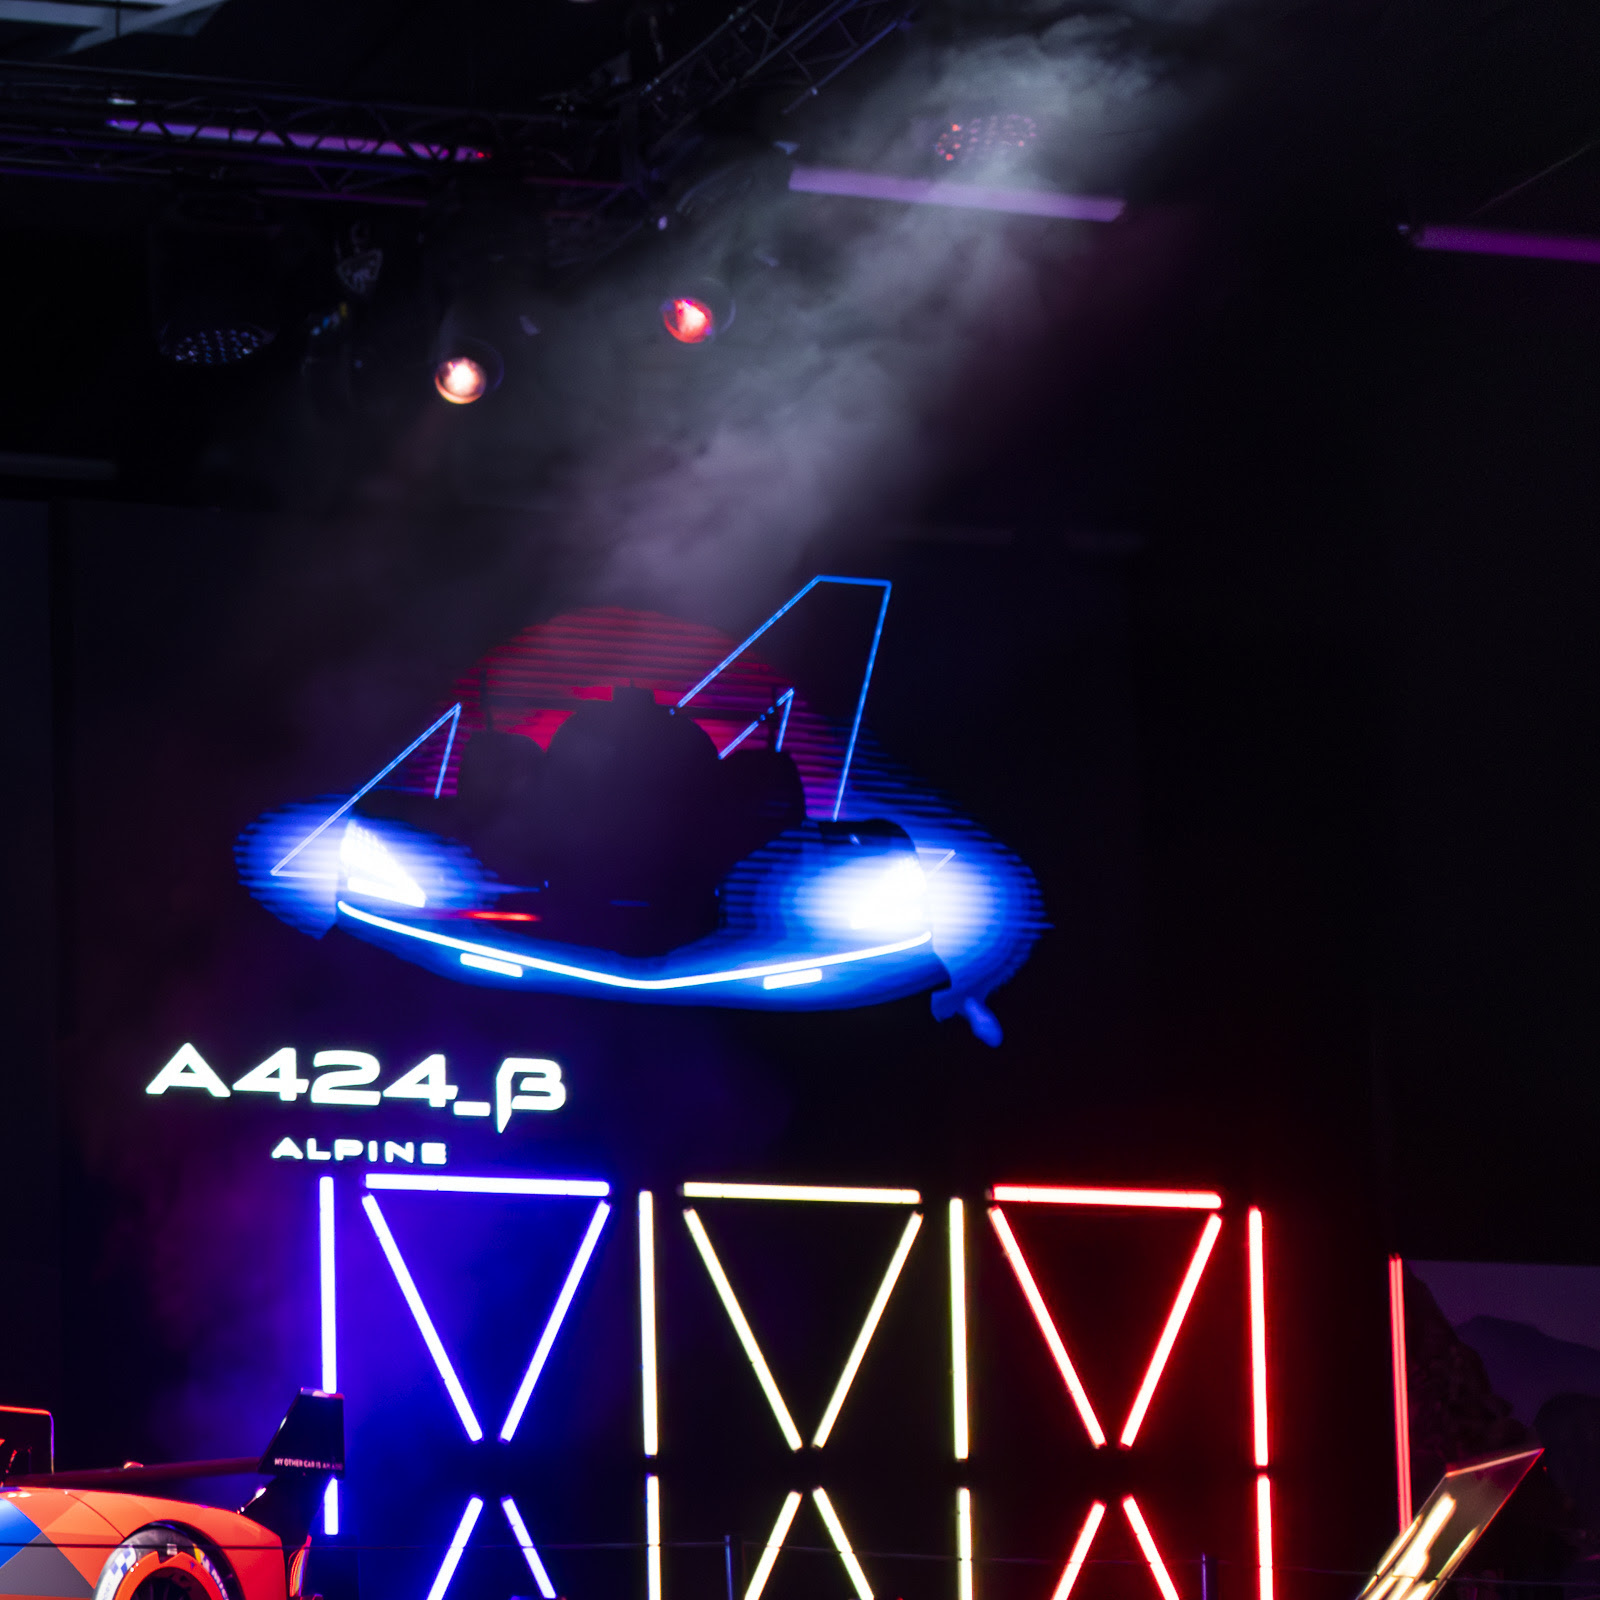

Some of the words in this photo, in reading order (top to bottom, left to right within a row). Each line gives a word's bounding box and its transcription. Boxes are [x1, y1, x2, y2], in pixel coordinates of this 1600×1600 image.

[270, 1136, 448, 1165] ALPINE
[284, 1458, 303, 1467] OTHER
[303, 1459, 315, 1469] CAR
